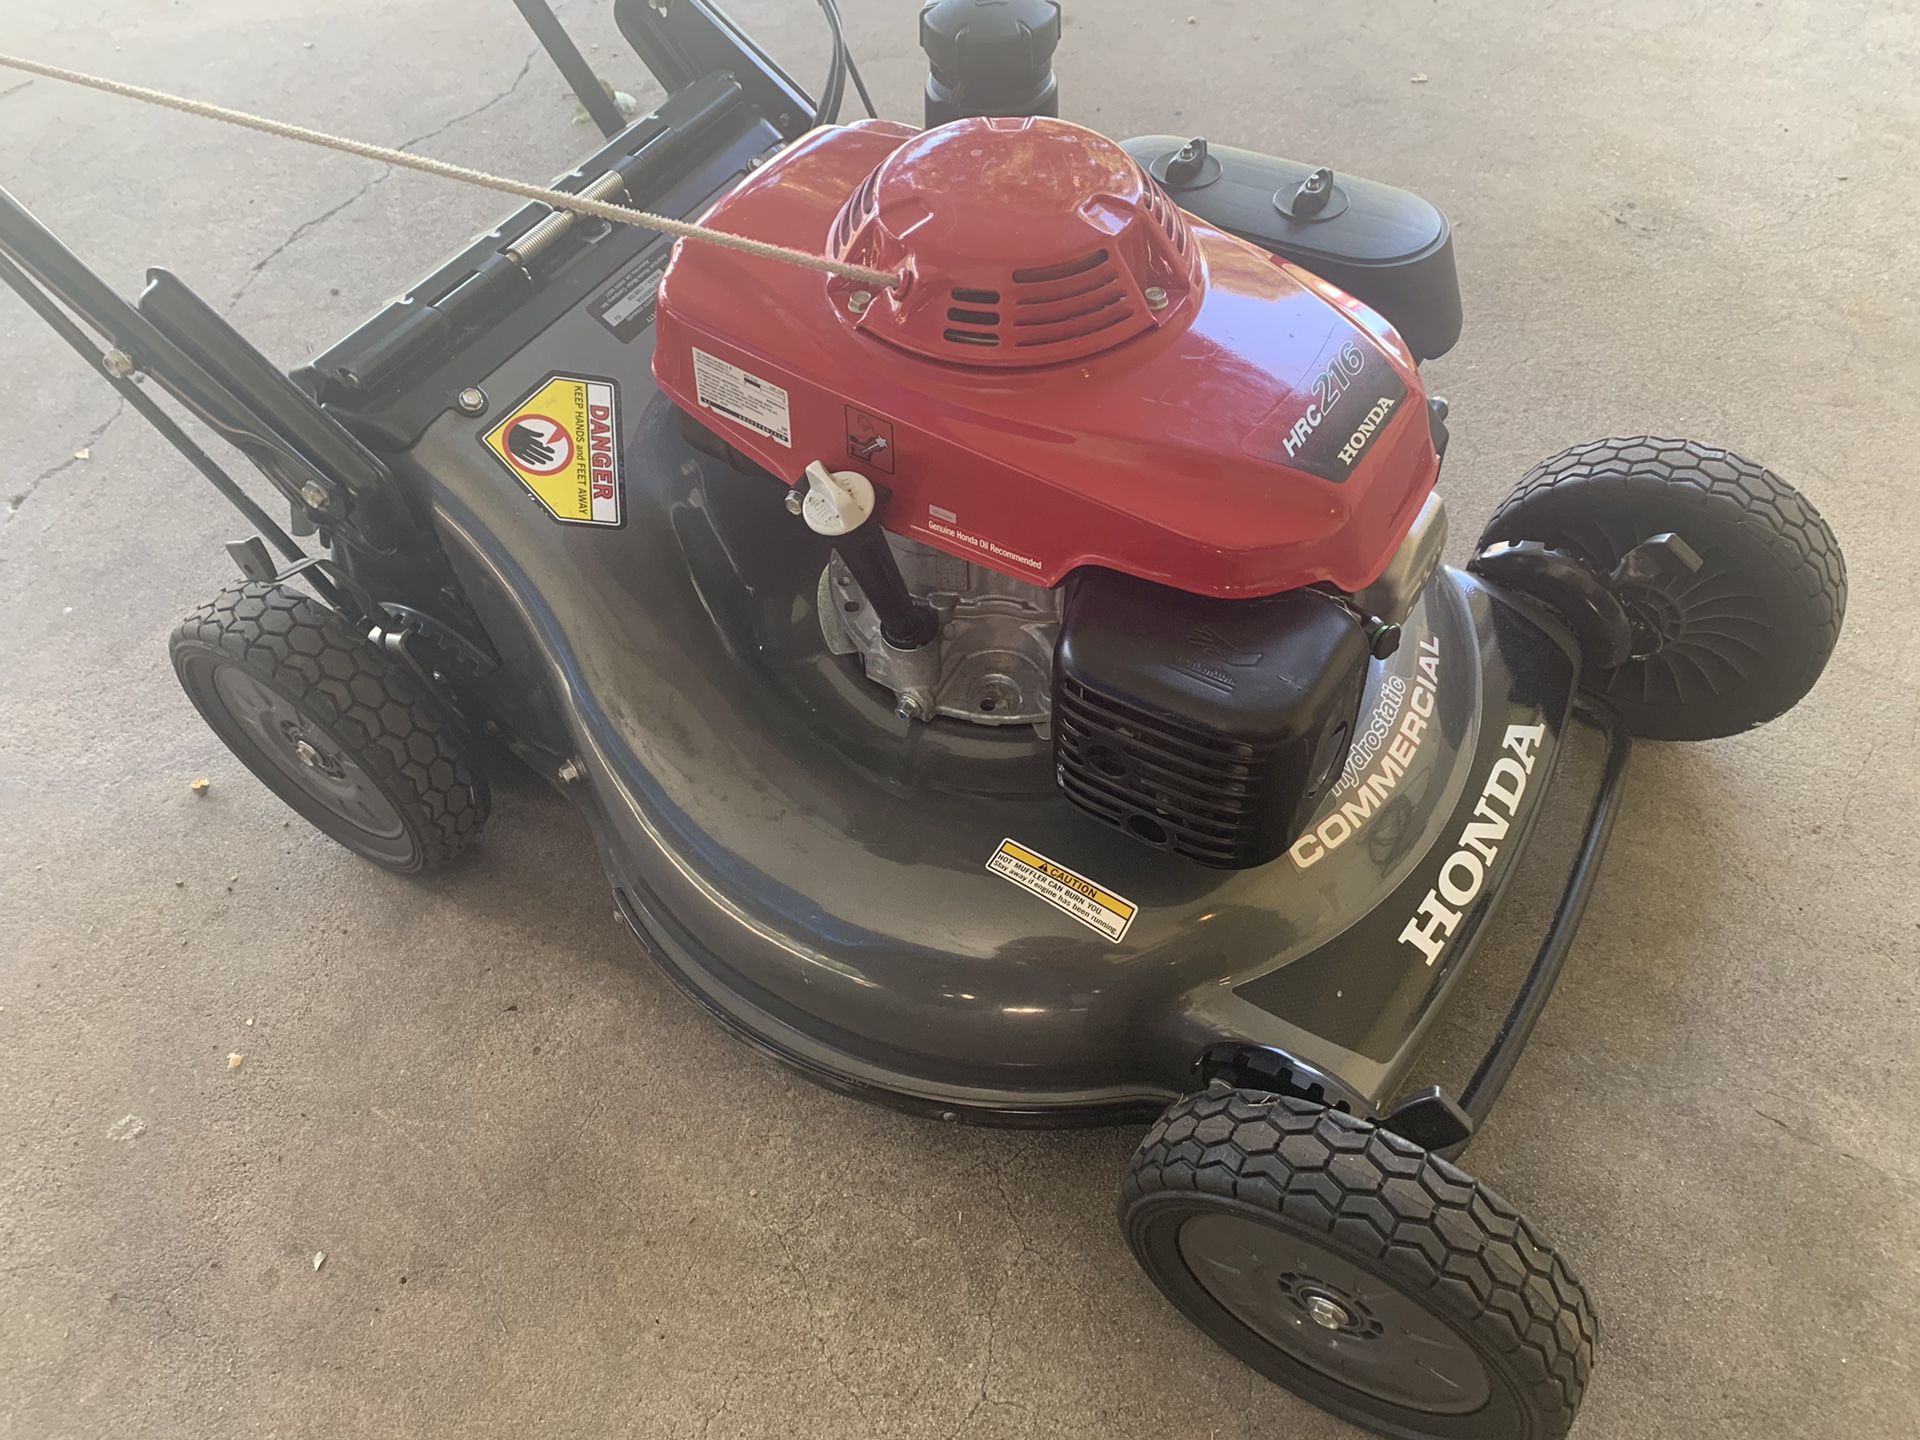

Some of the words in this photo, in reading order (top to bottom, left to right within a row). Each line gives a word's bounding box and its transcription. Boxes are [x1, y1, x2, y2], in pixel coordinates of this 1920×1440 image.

[574, 385, 584, 410] KEEP
[575, 410, 585, 443] HANDS
[1337, 396, 1395, 466] HONDA
[576, 445, 586, 460] and
[577, 462, 587, 486] FEET
[590, 404, 614, 500] DANGER
[578, 487, 588, 515] AWAY
[928, 520, 956, 538] Genuine
[956, 530, 979, 546] Honda
[979, 539, 989, 550] Oil
[990, 543, 1042, 570] Recommended
[1289, 635, 1440, 869] COMMERCIAL
[1397, 722, 1546, 967] HONDA
[993, 859, 1008, 872] Stay
[1008, 868, 1027, 882] away
[1027, 877, 1034, 885] if
[1033, 881, 1058, 898] engine
[1057, 893, 1071, 908] has
[1072, 902, 1090, 918] been
[997, 853, 1013, 865] HOT
[1013, 862, 1048, 884] MUFFLER
[1047, 879, 1064, 893] CAN
[1064, 889, 1086, 906] BURN
[1049, 868, 1098, 899] CAUTION
